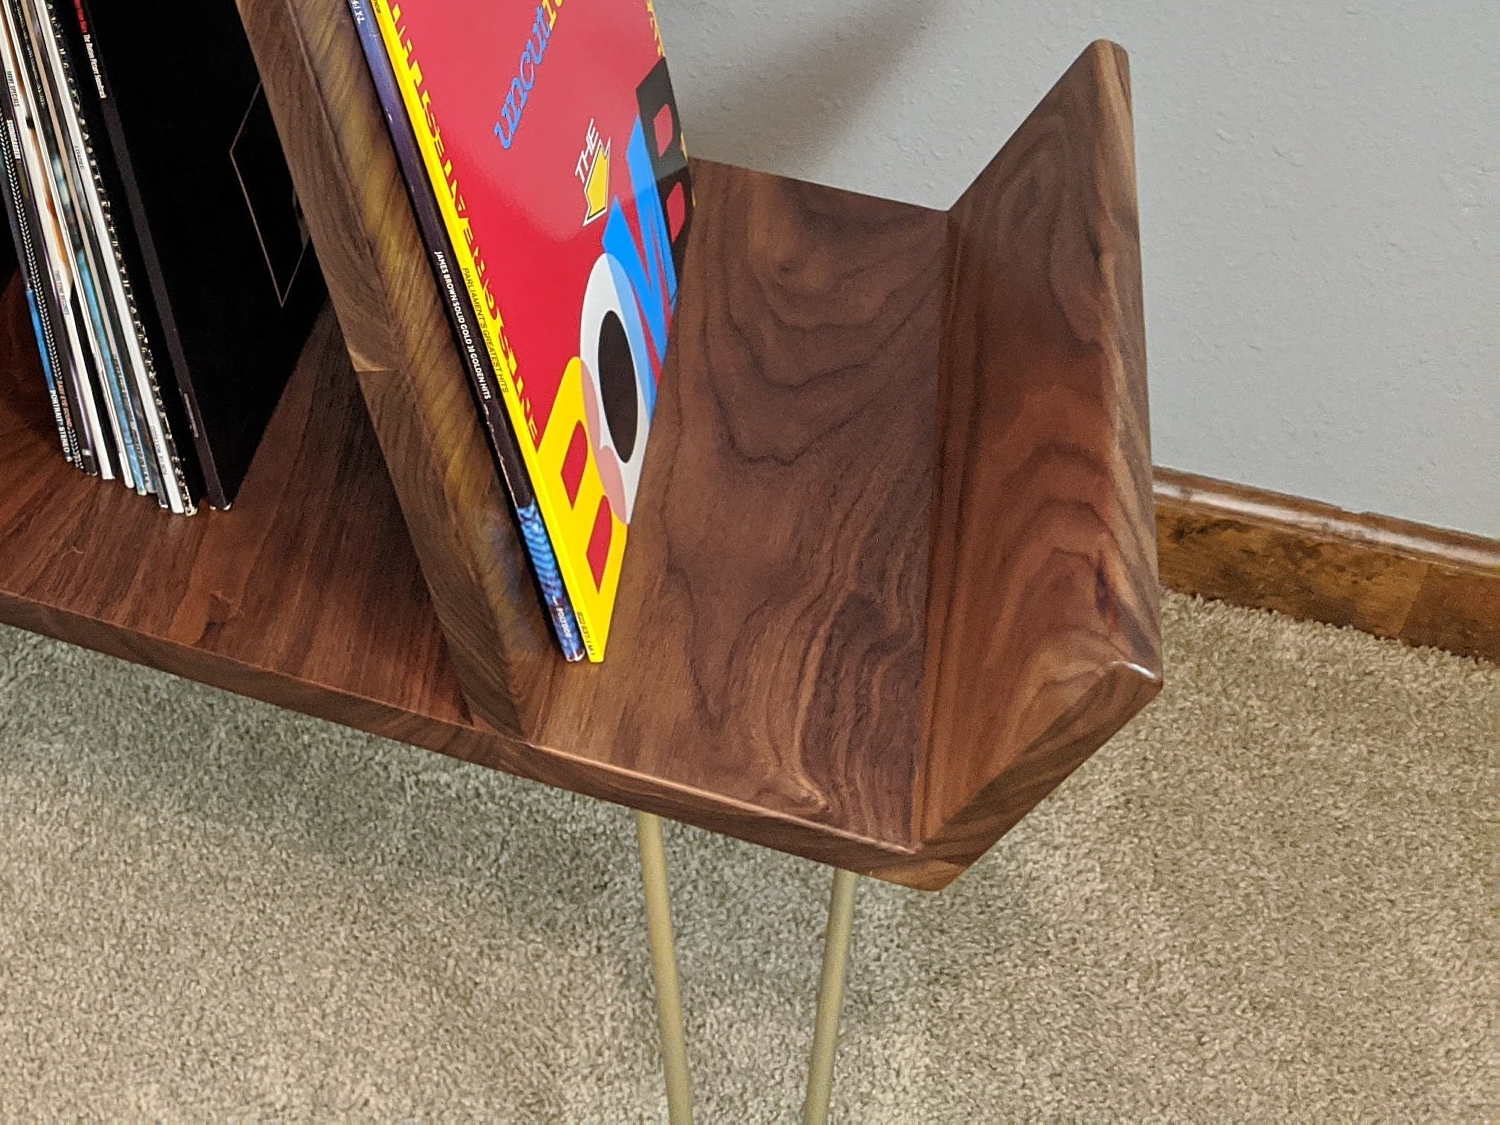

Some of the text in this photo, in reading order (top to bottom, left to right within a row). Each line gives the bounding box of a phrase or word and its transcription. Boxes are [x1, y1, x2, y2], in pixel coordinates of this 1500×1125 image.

[575, 119, 599, 181] THE
[434, 249, 449, 274] JAMES
[459, 323, 473, 345] GOLD
[468, 352, 485, 383] GOLDEN
[479, 382, 491, 400] HITS
[461, 266, 509, 394] PARLIAMENT'S GREATEST HITS
[58, 426, 71, 453] STEREO
[555, 606, 571, 639] POLYDOR
